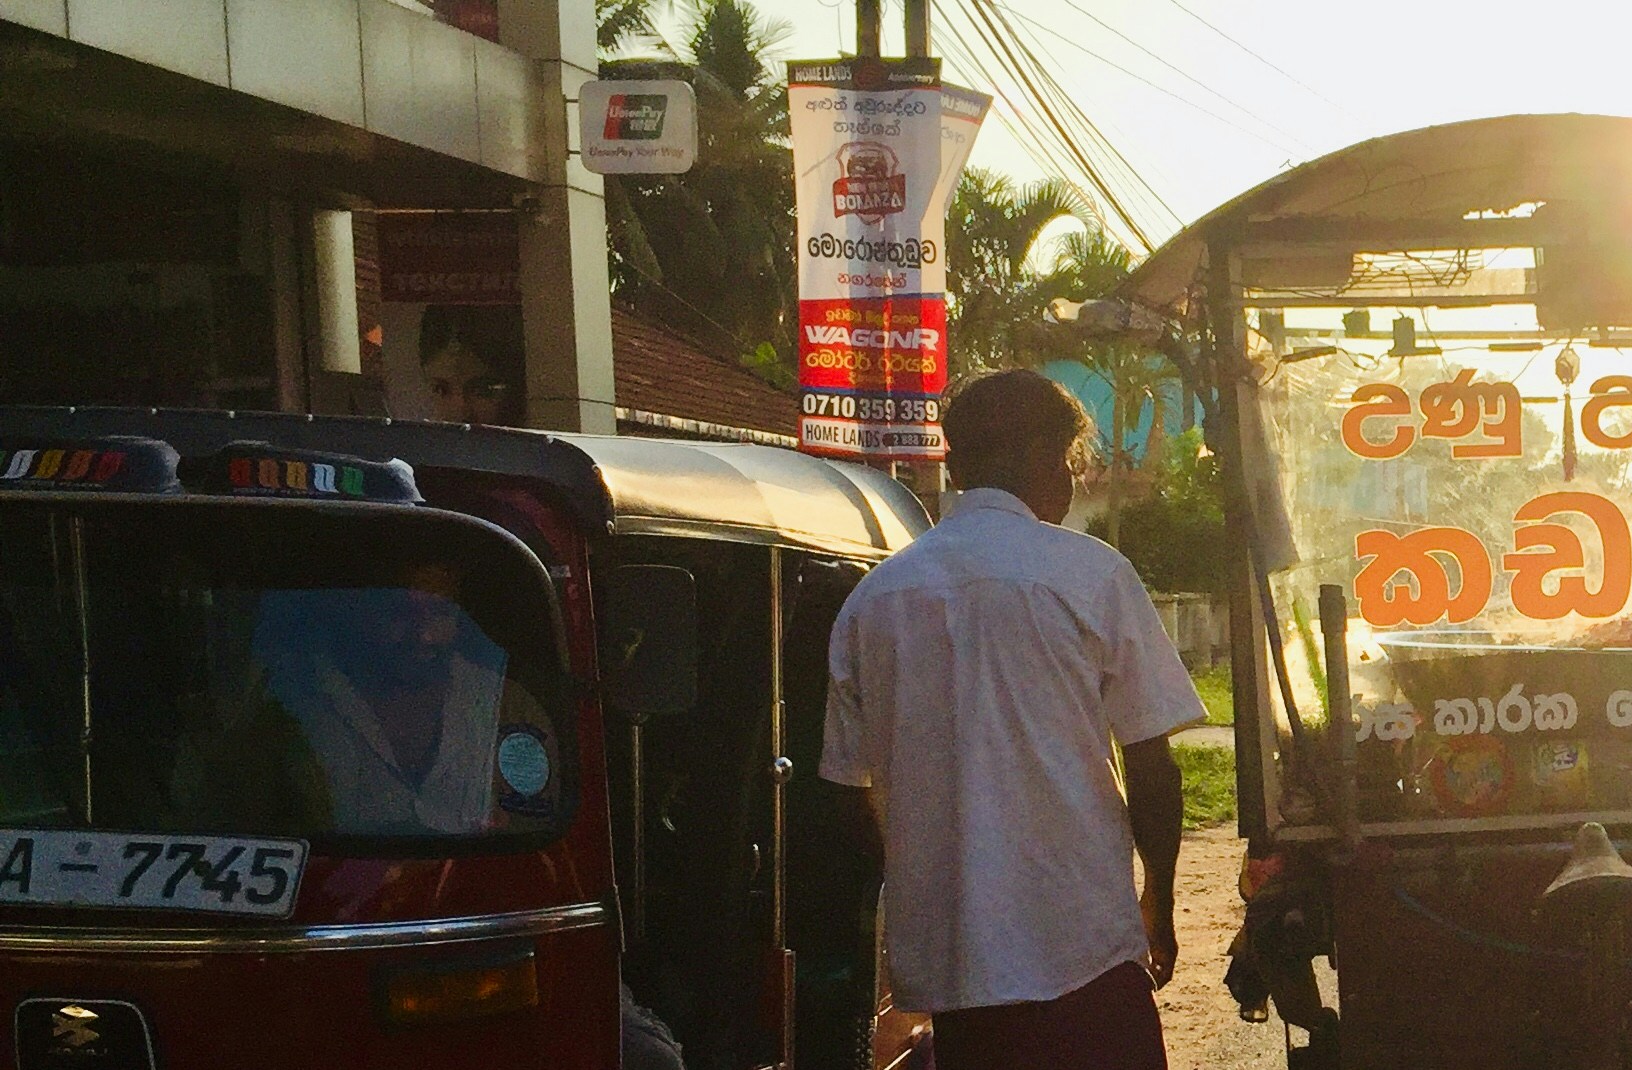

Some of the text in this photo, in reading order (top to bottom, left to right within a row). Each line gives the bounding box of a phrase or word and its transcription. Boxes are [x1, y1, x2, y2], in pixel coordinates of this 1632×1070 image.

[835, 191, 903, 211] BONANZA
[802, 393, 939, 422] 0710 359 359
[1341, 369, 1522, 460] උණු
[805, 423, 839, 443] HOME
[843, 427, 880, 448] LANDS
[1433, 683, 1580, 737] කාරක
[117, 841, 294, 903] 7745
